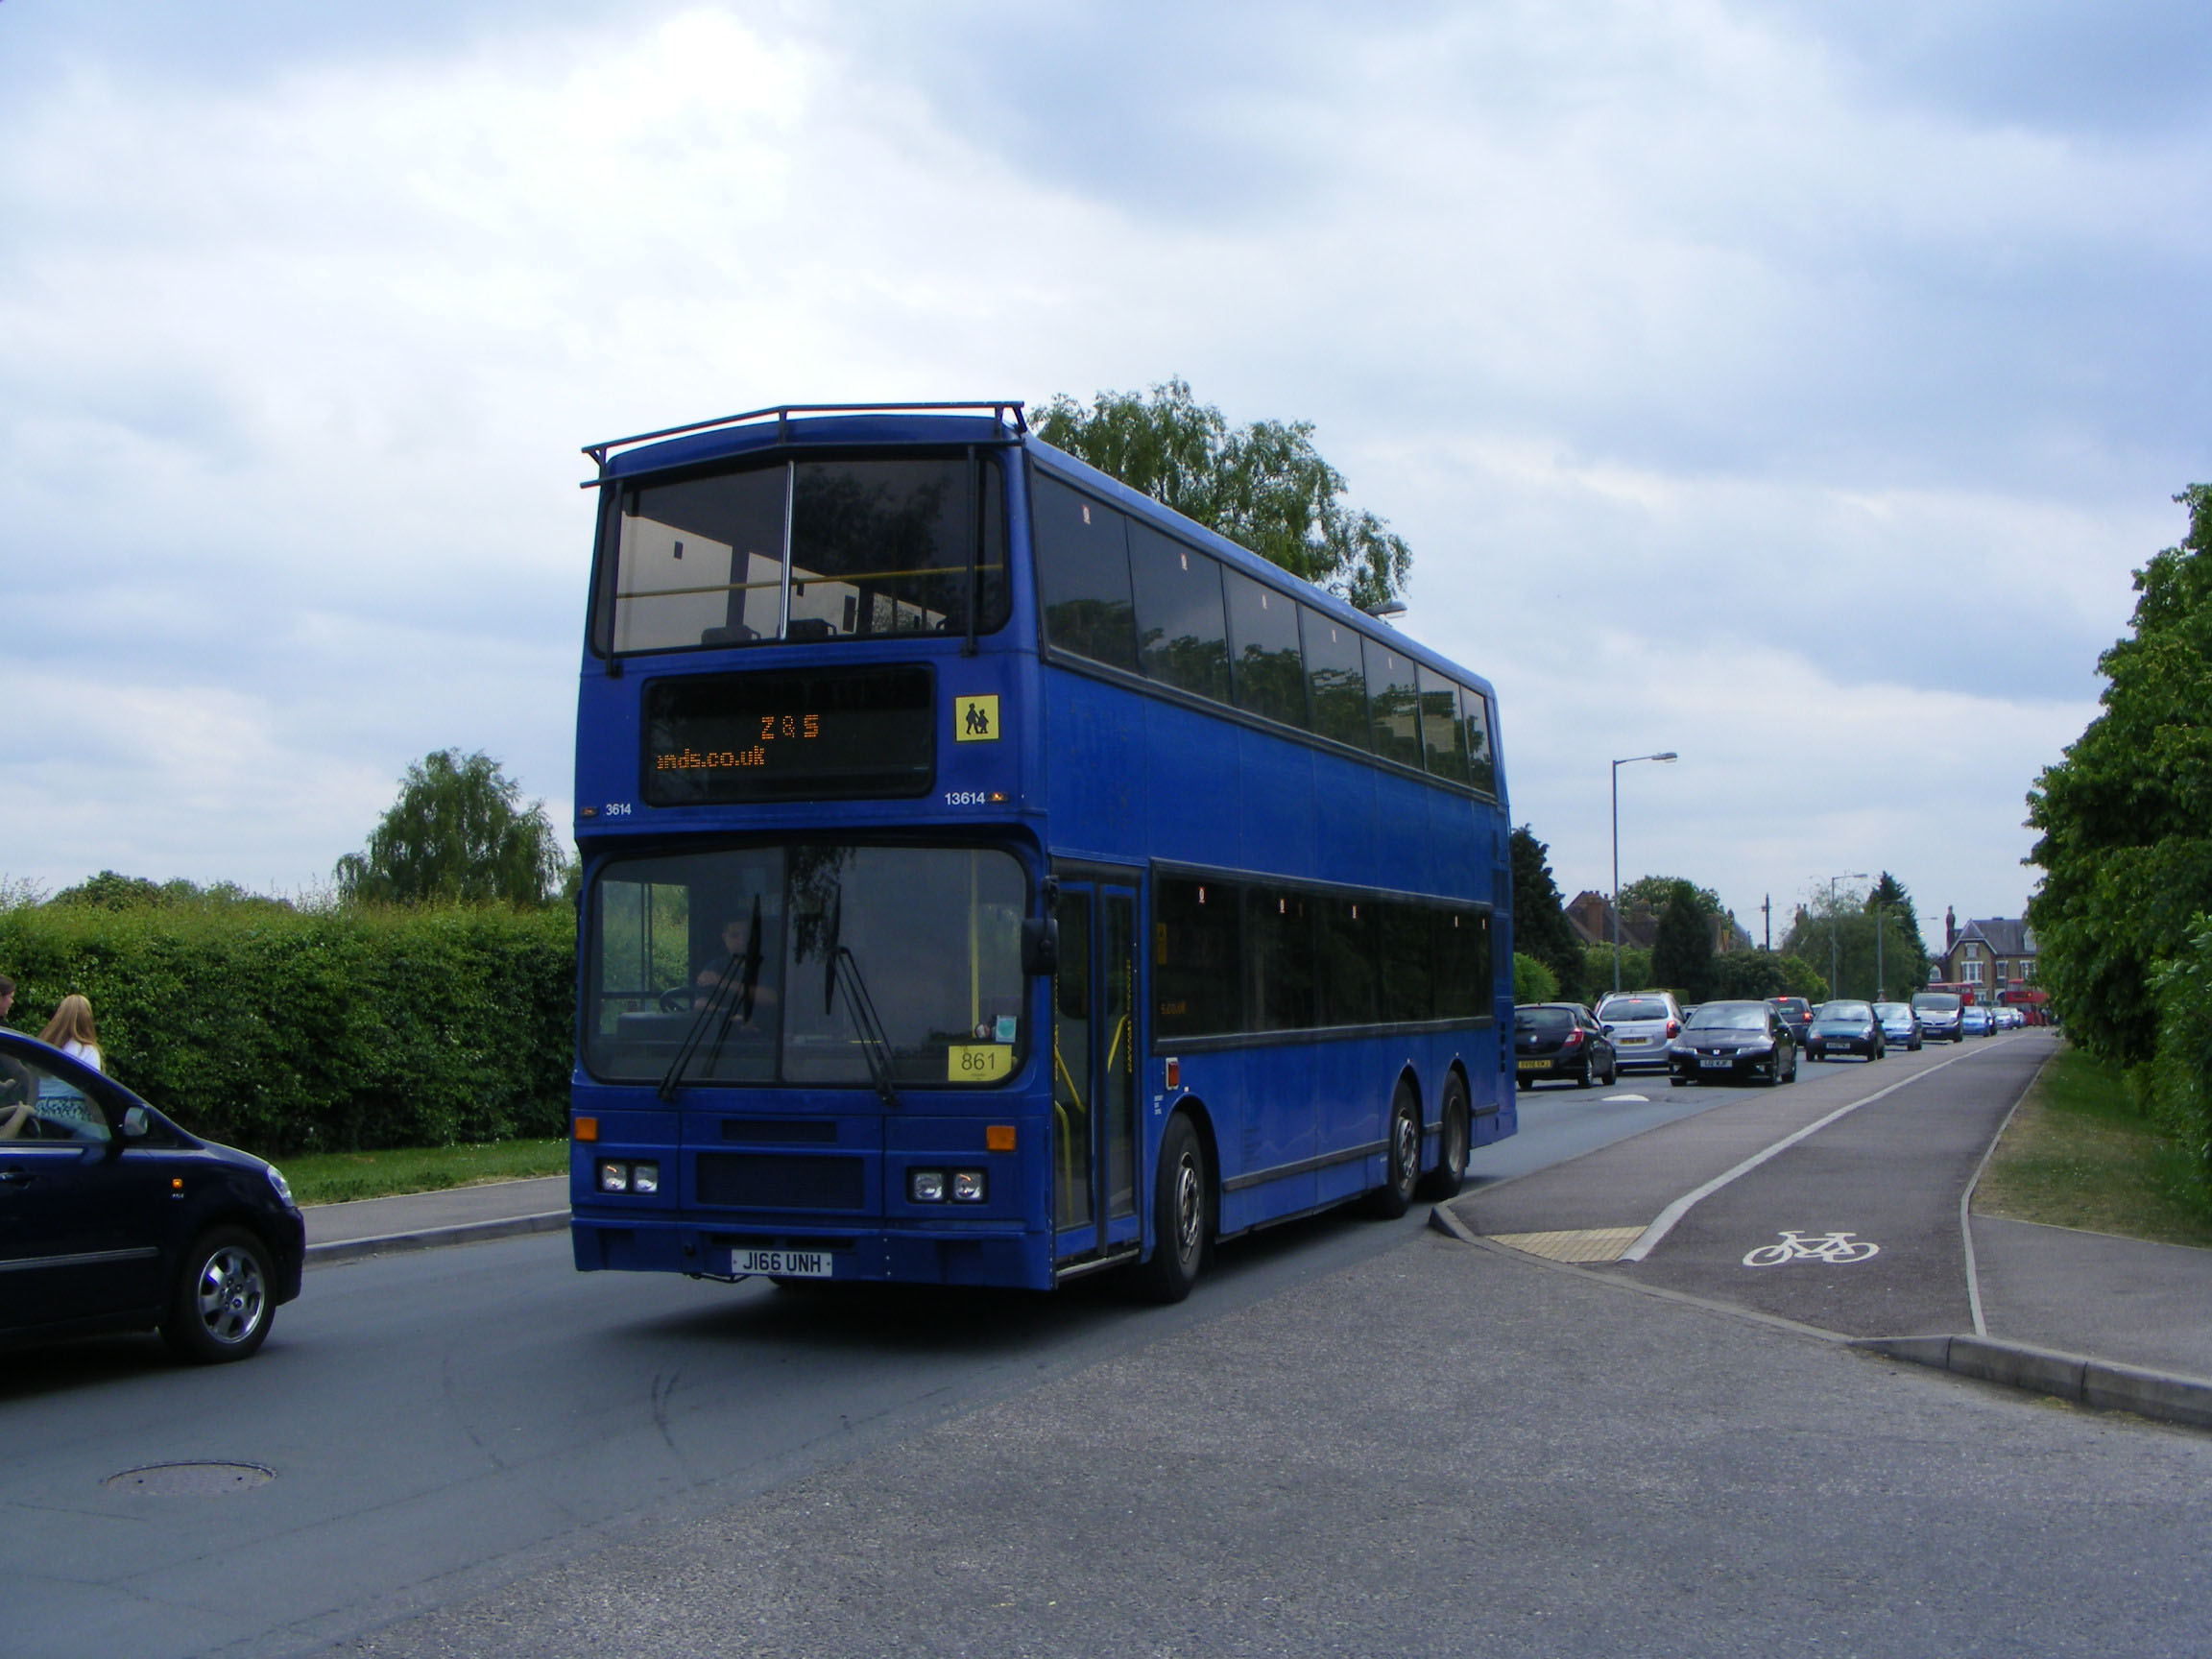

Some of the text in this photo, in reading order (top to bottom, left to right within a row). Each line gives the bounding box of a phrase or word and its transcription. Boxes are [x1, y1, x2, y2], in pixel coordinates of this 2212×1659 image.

[761, 716, 775, 740] Z
[782, 715, 795, 737] &
[945, 791, 986, 805] 13614
[606, 803, 632, 816] 3614
[961, 1052, 995, 1070] 861
[743, 1252, 821, 1273] J166 UNH
